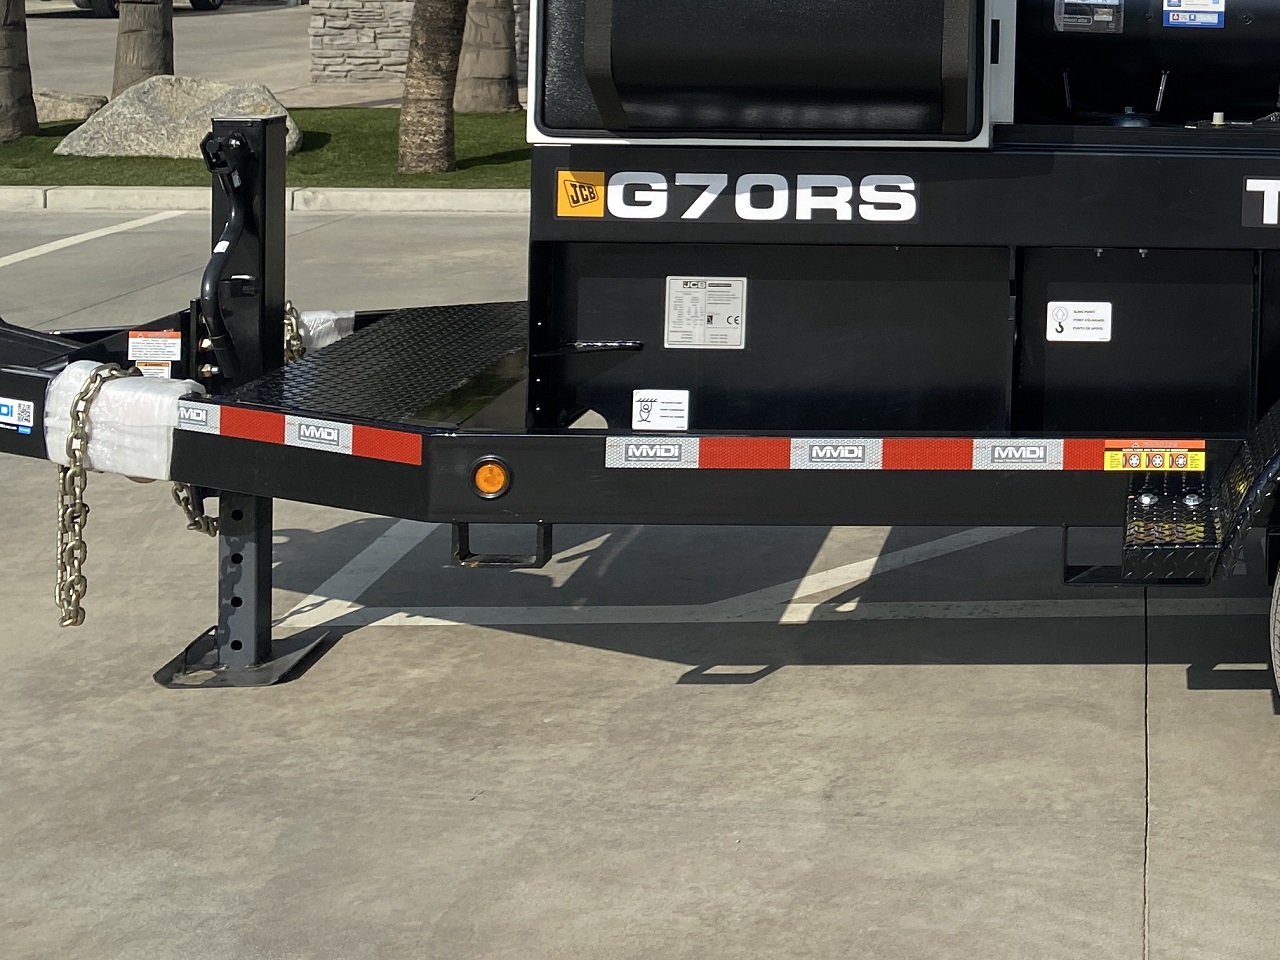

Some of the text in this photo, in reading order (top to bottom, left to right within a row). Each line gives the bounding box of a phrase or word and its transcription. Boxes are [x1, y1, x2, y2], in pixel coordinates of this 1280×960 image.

[570, 182, 597, 206] JCB
[606, 171, 917, 222] G70RS
[683, 281, 706, 289] JCB
